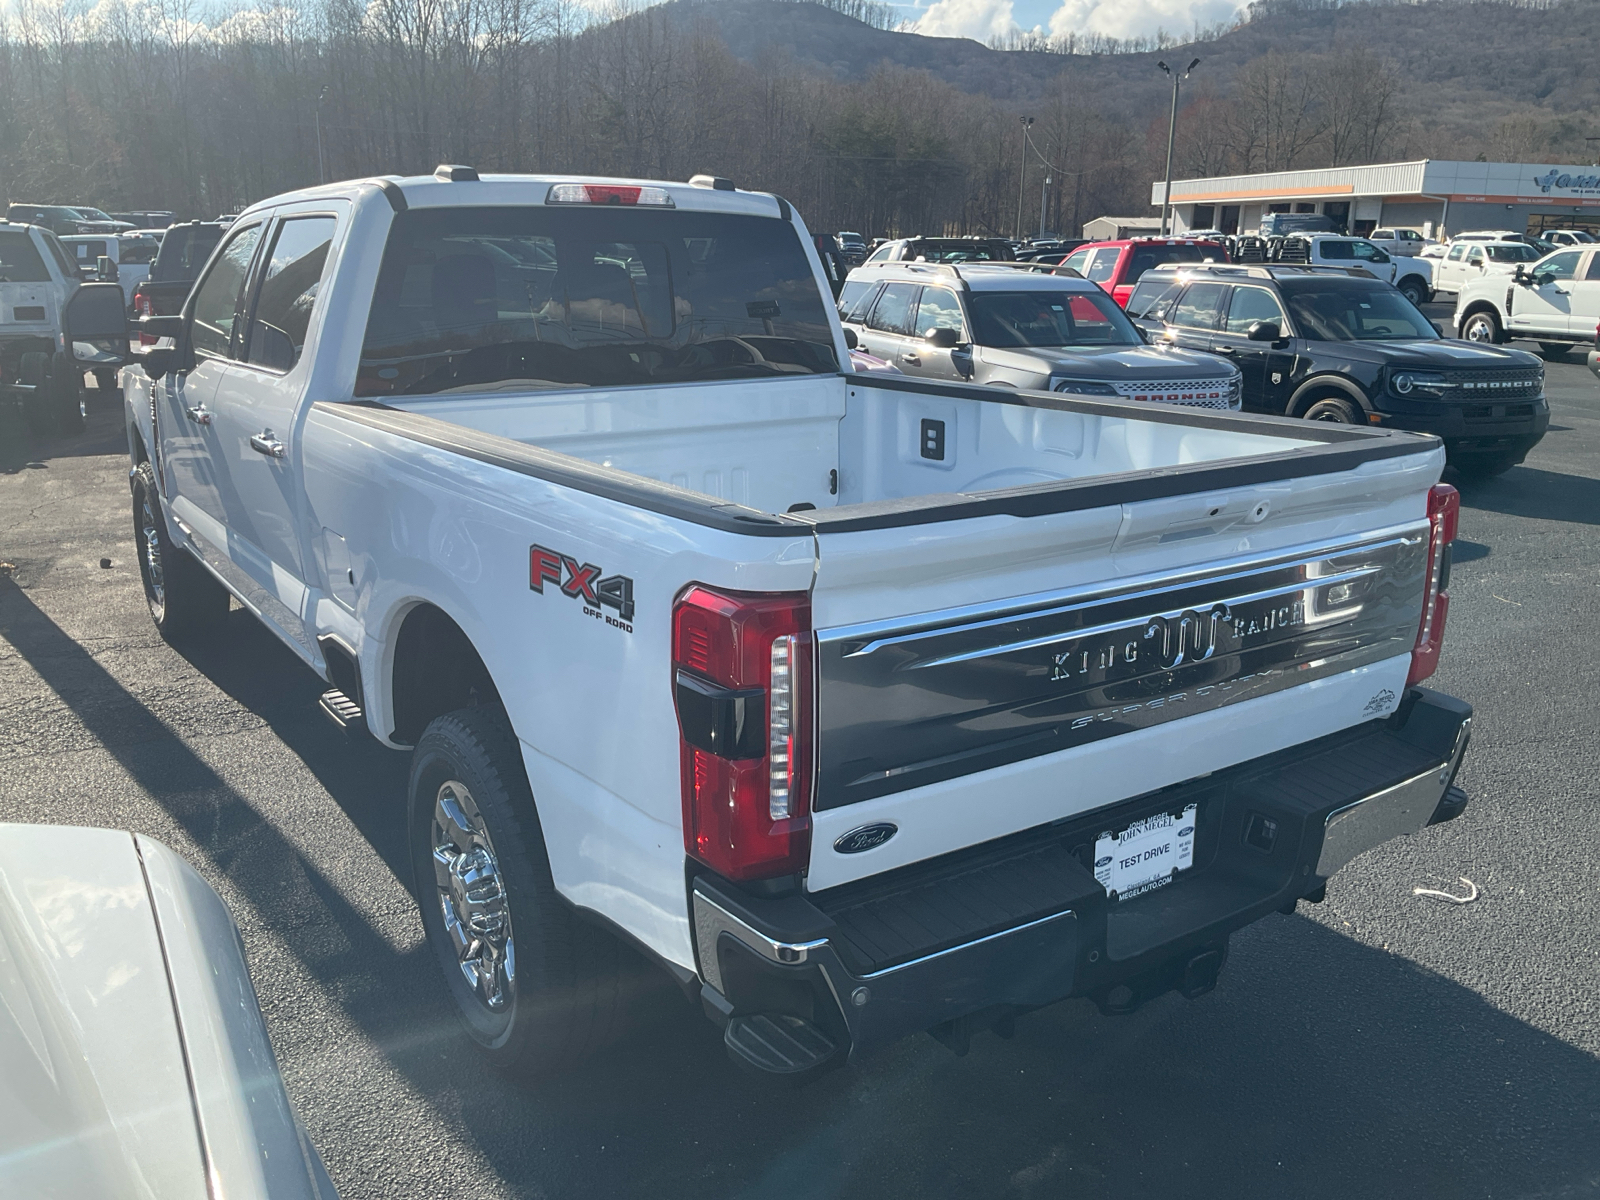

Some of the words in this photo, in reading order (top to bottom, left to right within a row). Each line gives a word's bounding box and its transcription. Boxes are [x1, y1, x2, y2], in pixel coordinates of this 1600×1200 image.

[1134, 392, 1220, 401] BRONCO
[1463, 381, 1533, 389] BRONCO
[529, 543, 635, 623] FX4
[583, 606, 602, 619] OFF
[605, 615, 633, 633] ROAD
[1051, 641, 1138, 681] KING
[1231, 602, 1306, 639] RANCH
[1071, 692, 1188, 730] SUPER
[1118, 825, 1142, 846] JOHN
[1143, 816, 1174, 833] MEGEL
[1128, 818, 1146, 830] JOHN
[1147, 812, 1168, 824] MEGEL
[1119, 853, 1142, 869] TEST
[1144, 843, 1170, 861] DRIVE
[1119, 876, 1173, 901] MEGELAUTO.COM
